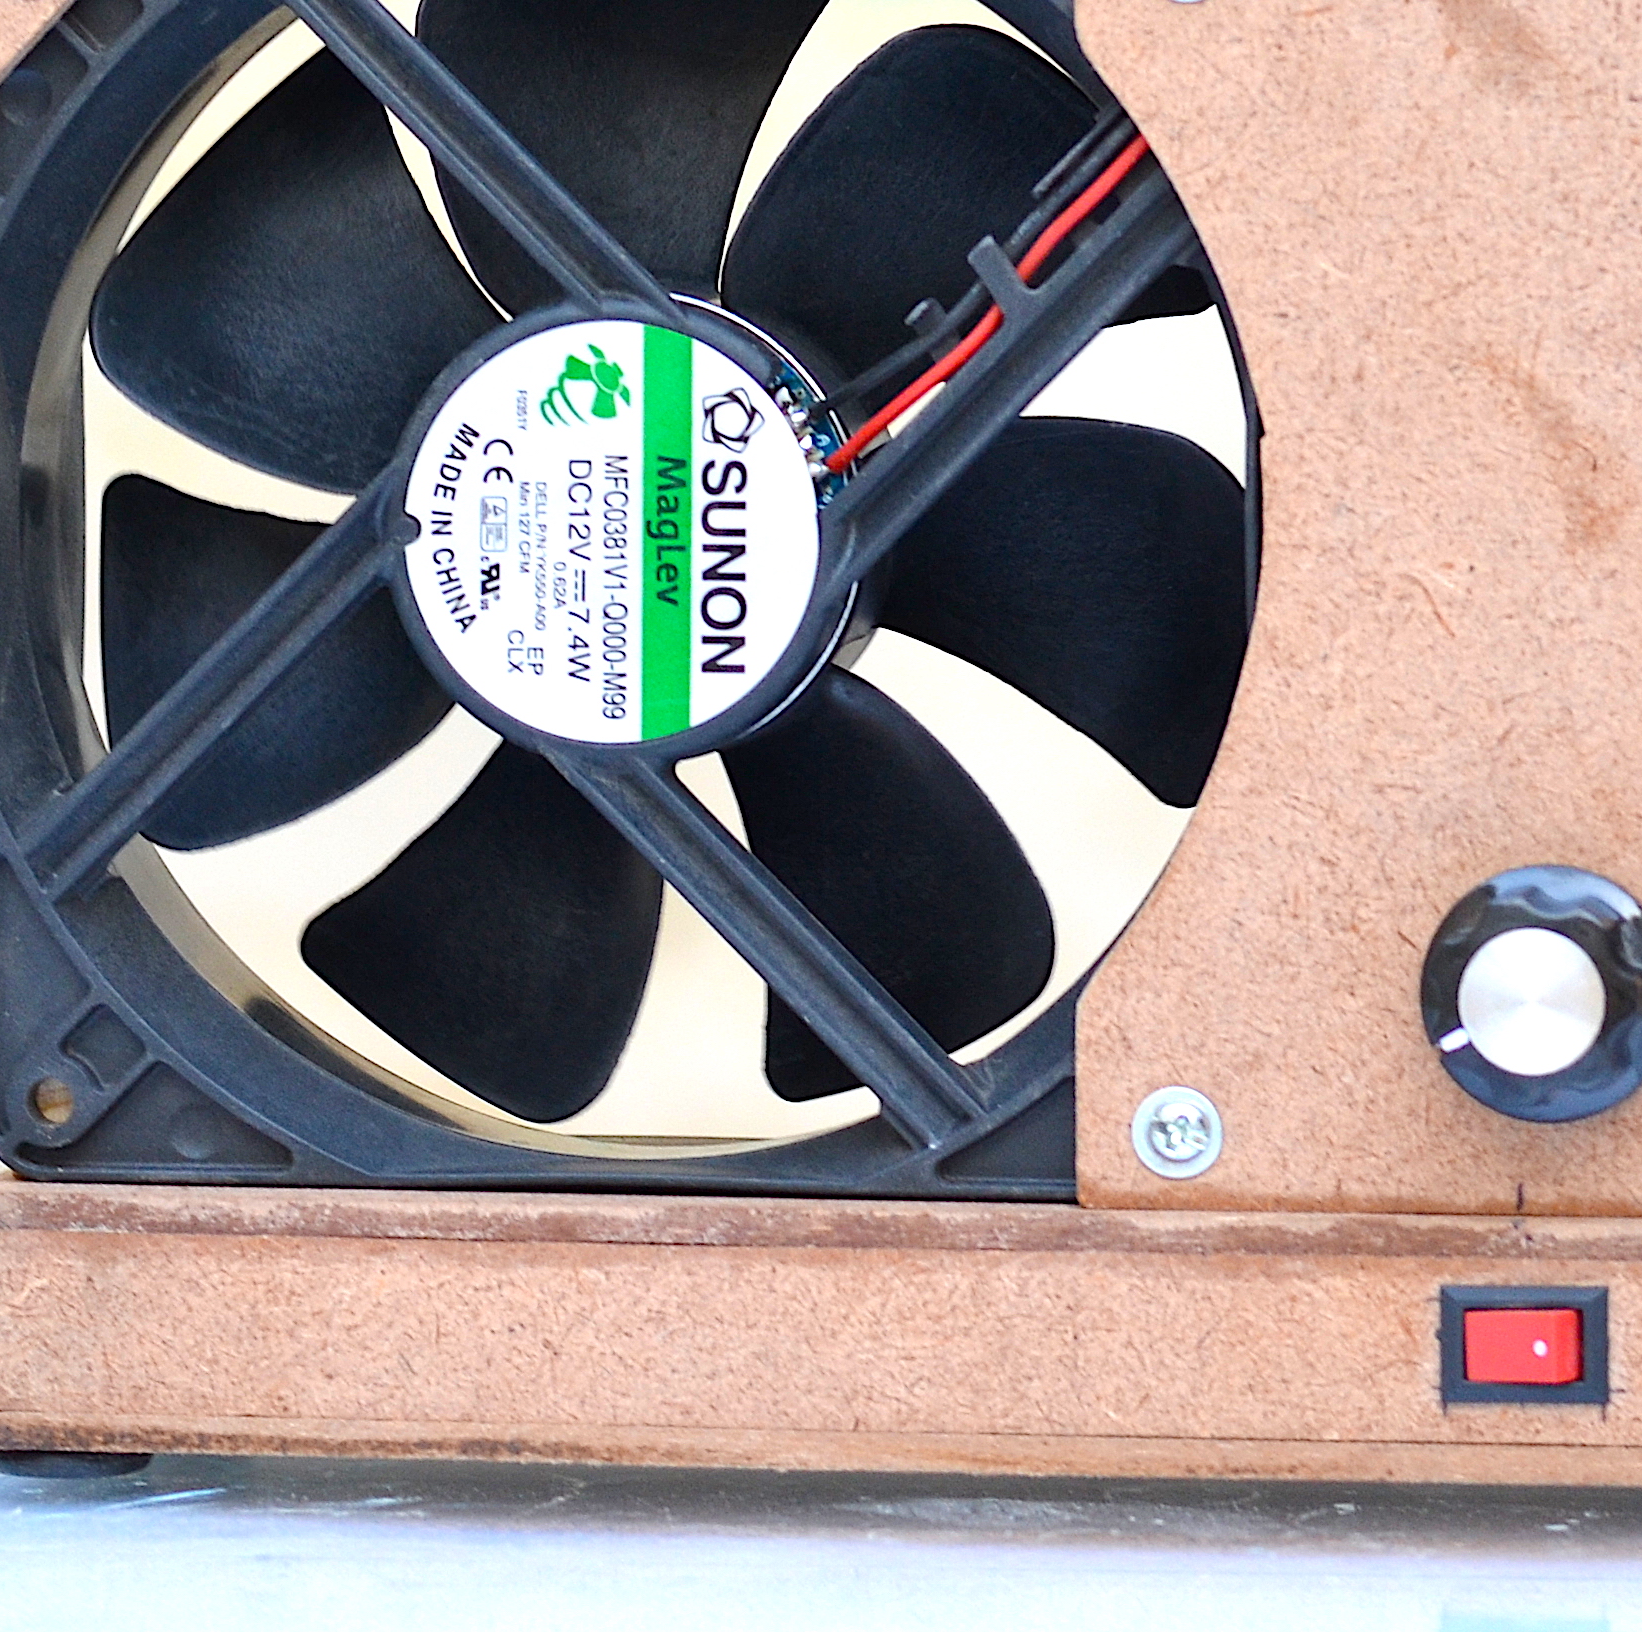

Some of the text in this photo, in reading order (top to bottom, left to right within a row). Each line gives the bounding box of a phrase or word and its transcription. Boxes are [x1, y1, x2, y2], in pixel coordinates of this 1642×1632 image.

[430, 422, 482, 633] MADE IN CHINA
[518, 481, 531, 574] Min 127 CFM
[534, 481, 548, 518] DELL
[647, 455, 688, 607] MagLev
[553, 561, 566, 609] 0.62A
[602, 454, 629, 720] MFC0381V1-Q000-M99
[700, 459, 748, 674] SUNON
[507, 629, 526, 674] CLX
[527, 647, 545, 676] EP
